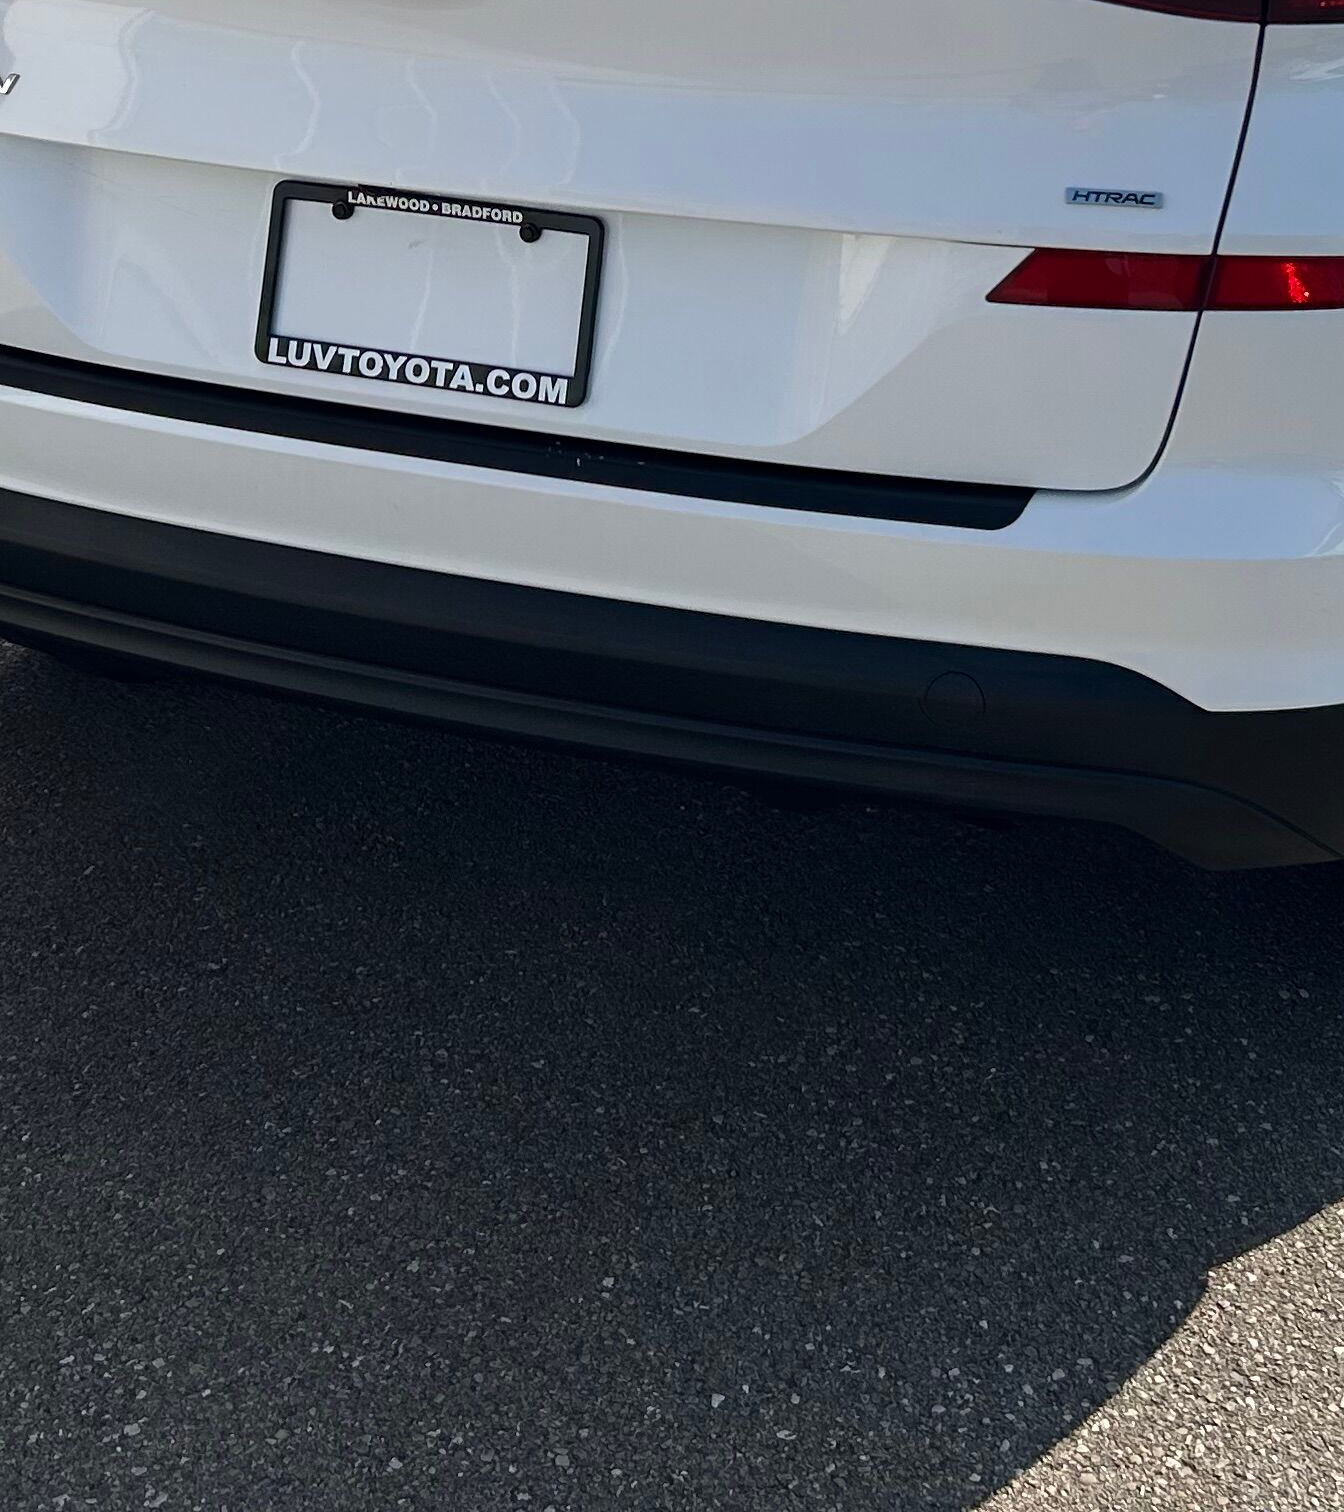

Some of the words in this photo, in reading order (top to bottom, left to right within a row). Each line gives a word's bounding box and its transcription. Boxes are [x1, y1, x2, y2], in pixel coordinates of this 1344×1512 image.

[1071, 190, 1156, 206] HTRAC
[441, 202, 524, 224] BRADFORD
[267, 337, 569, 405] LUVTOYOTA.COM
